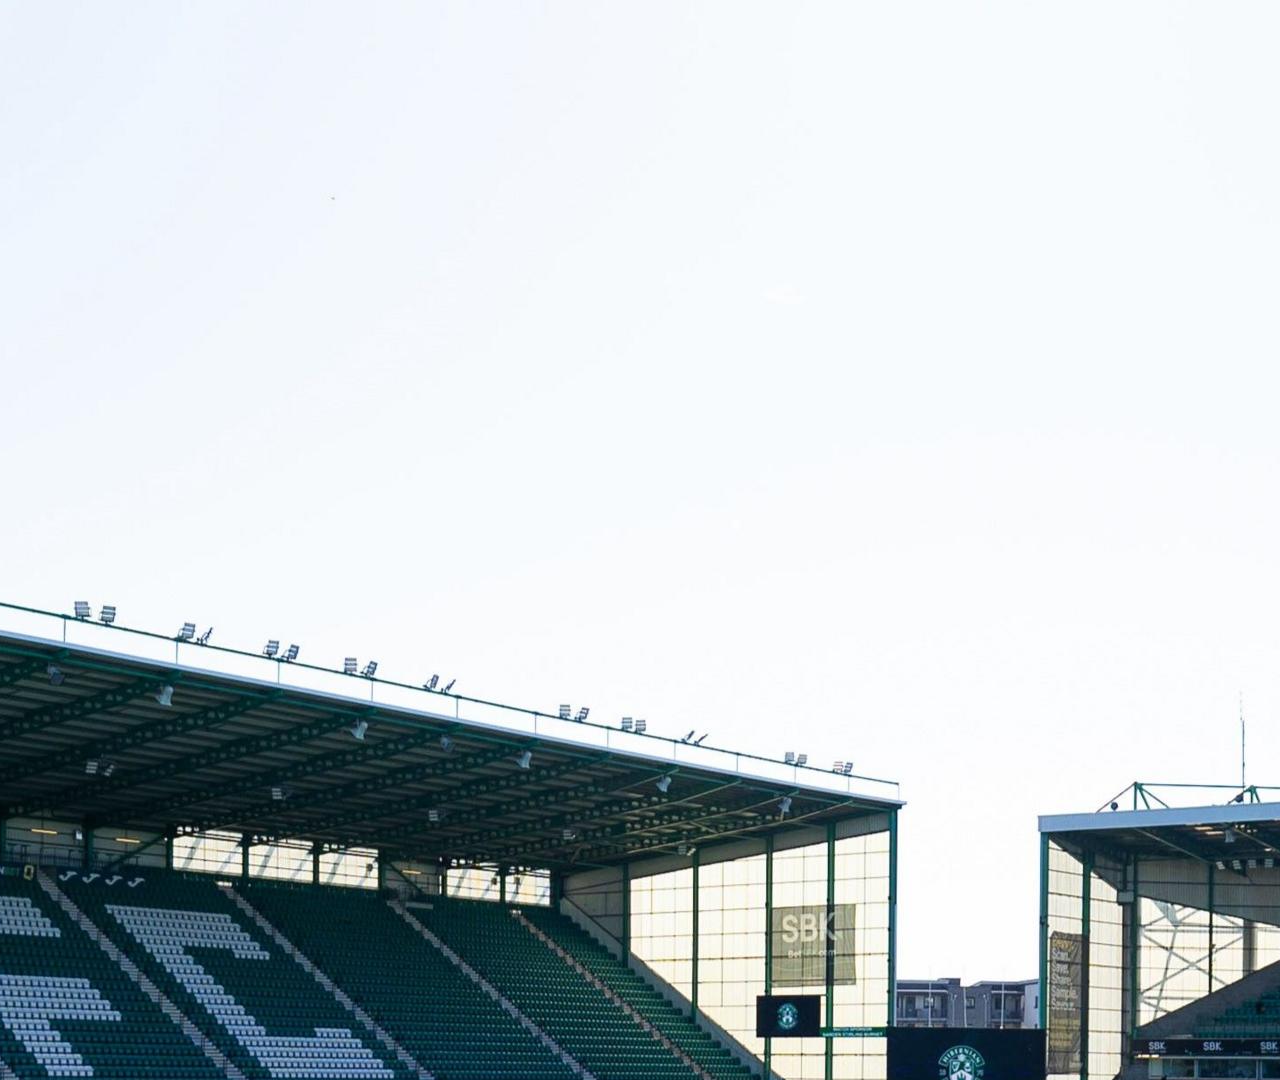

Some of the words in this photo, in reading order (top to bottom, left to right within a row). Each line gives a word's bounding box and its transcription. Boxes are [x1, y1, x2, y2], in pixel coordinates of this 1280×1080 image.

[781, 911, 838, 943] SBK
[1149, 1042, 1166, 1050] SBK
[1203, 1042, 1222, 1051] SBK
[1260, 1042, 1278, 1050] SBK
[943, 1048, 980, 1063] HIBERNIAN
